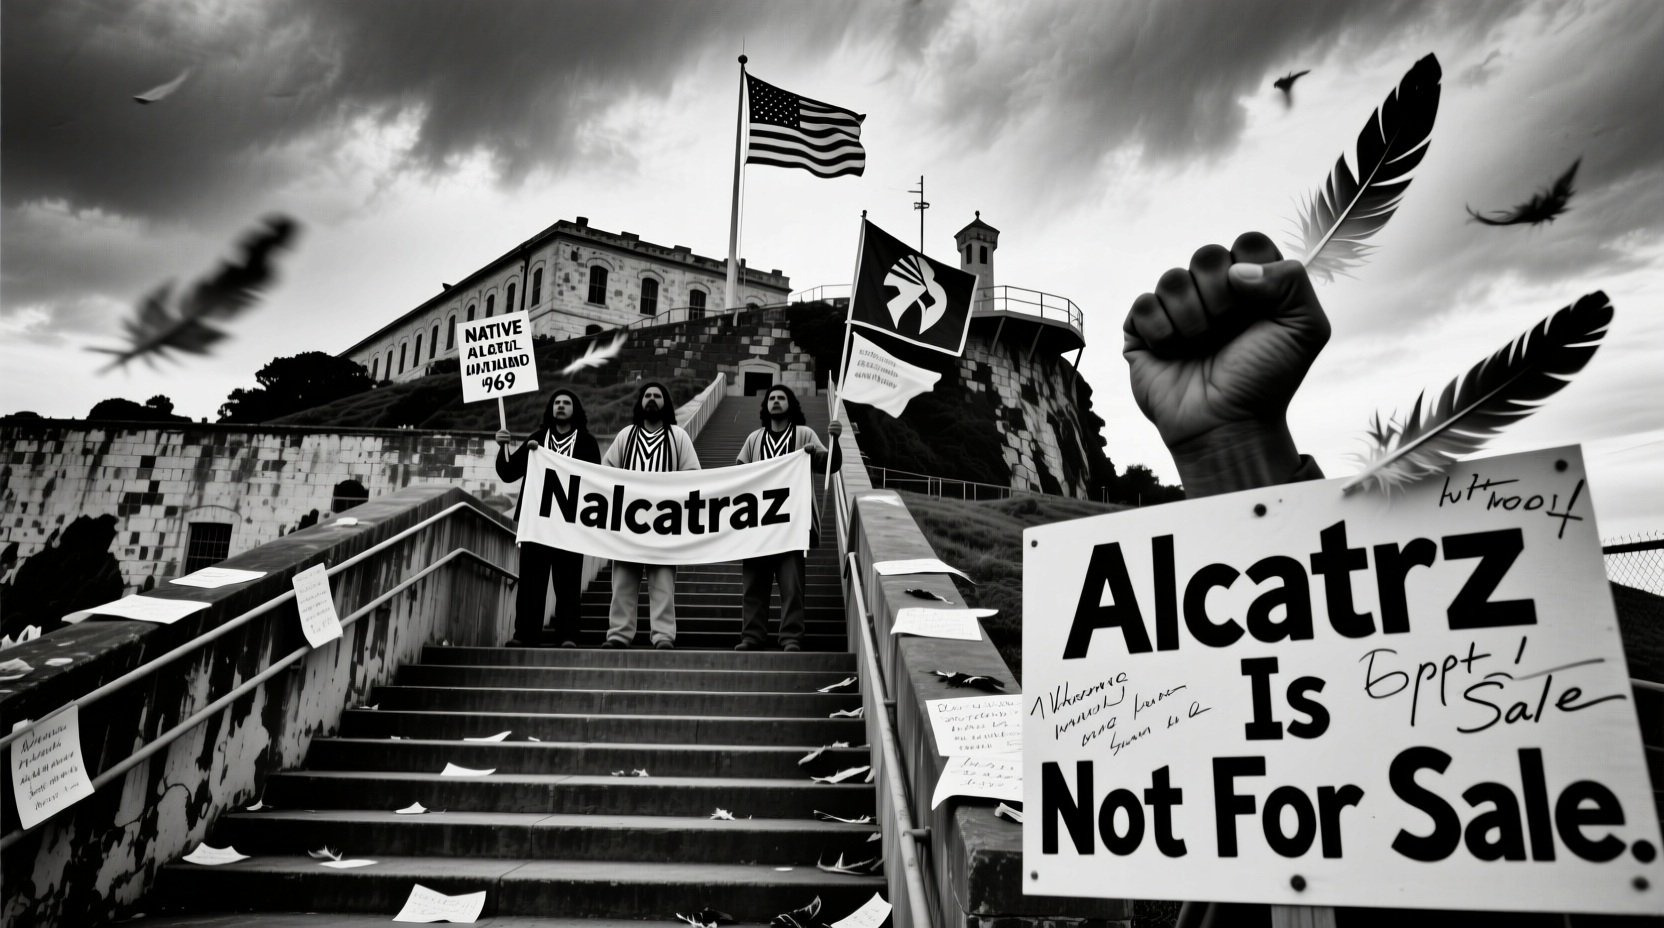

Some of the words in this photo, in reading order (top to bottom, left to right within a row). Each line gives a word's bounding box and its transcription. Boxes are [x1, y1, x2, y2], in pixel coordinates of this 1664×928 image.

[465, 319, 523, 343] NATIVE
[538, 468, 791, 536] Nalcatraz
[1063, 520, 1538, 660] Alcatrz
[1241, 657, 1331, 741] Is
[1456, 674, 1627, 734] Sale
[1041, 760, 1188, 858] Not
[1213, 755, 1365, 858] For
[1388, 745, 1658, 864] Sale.
